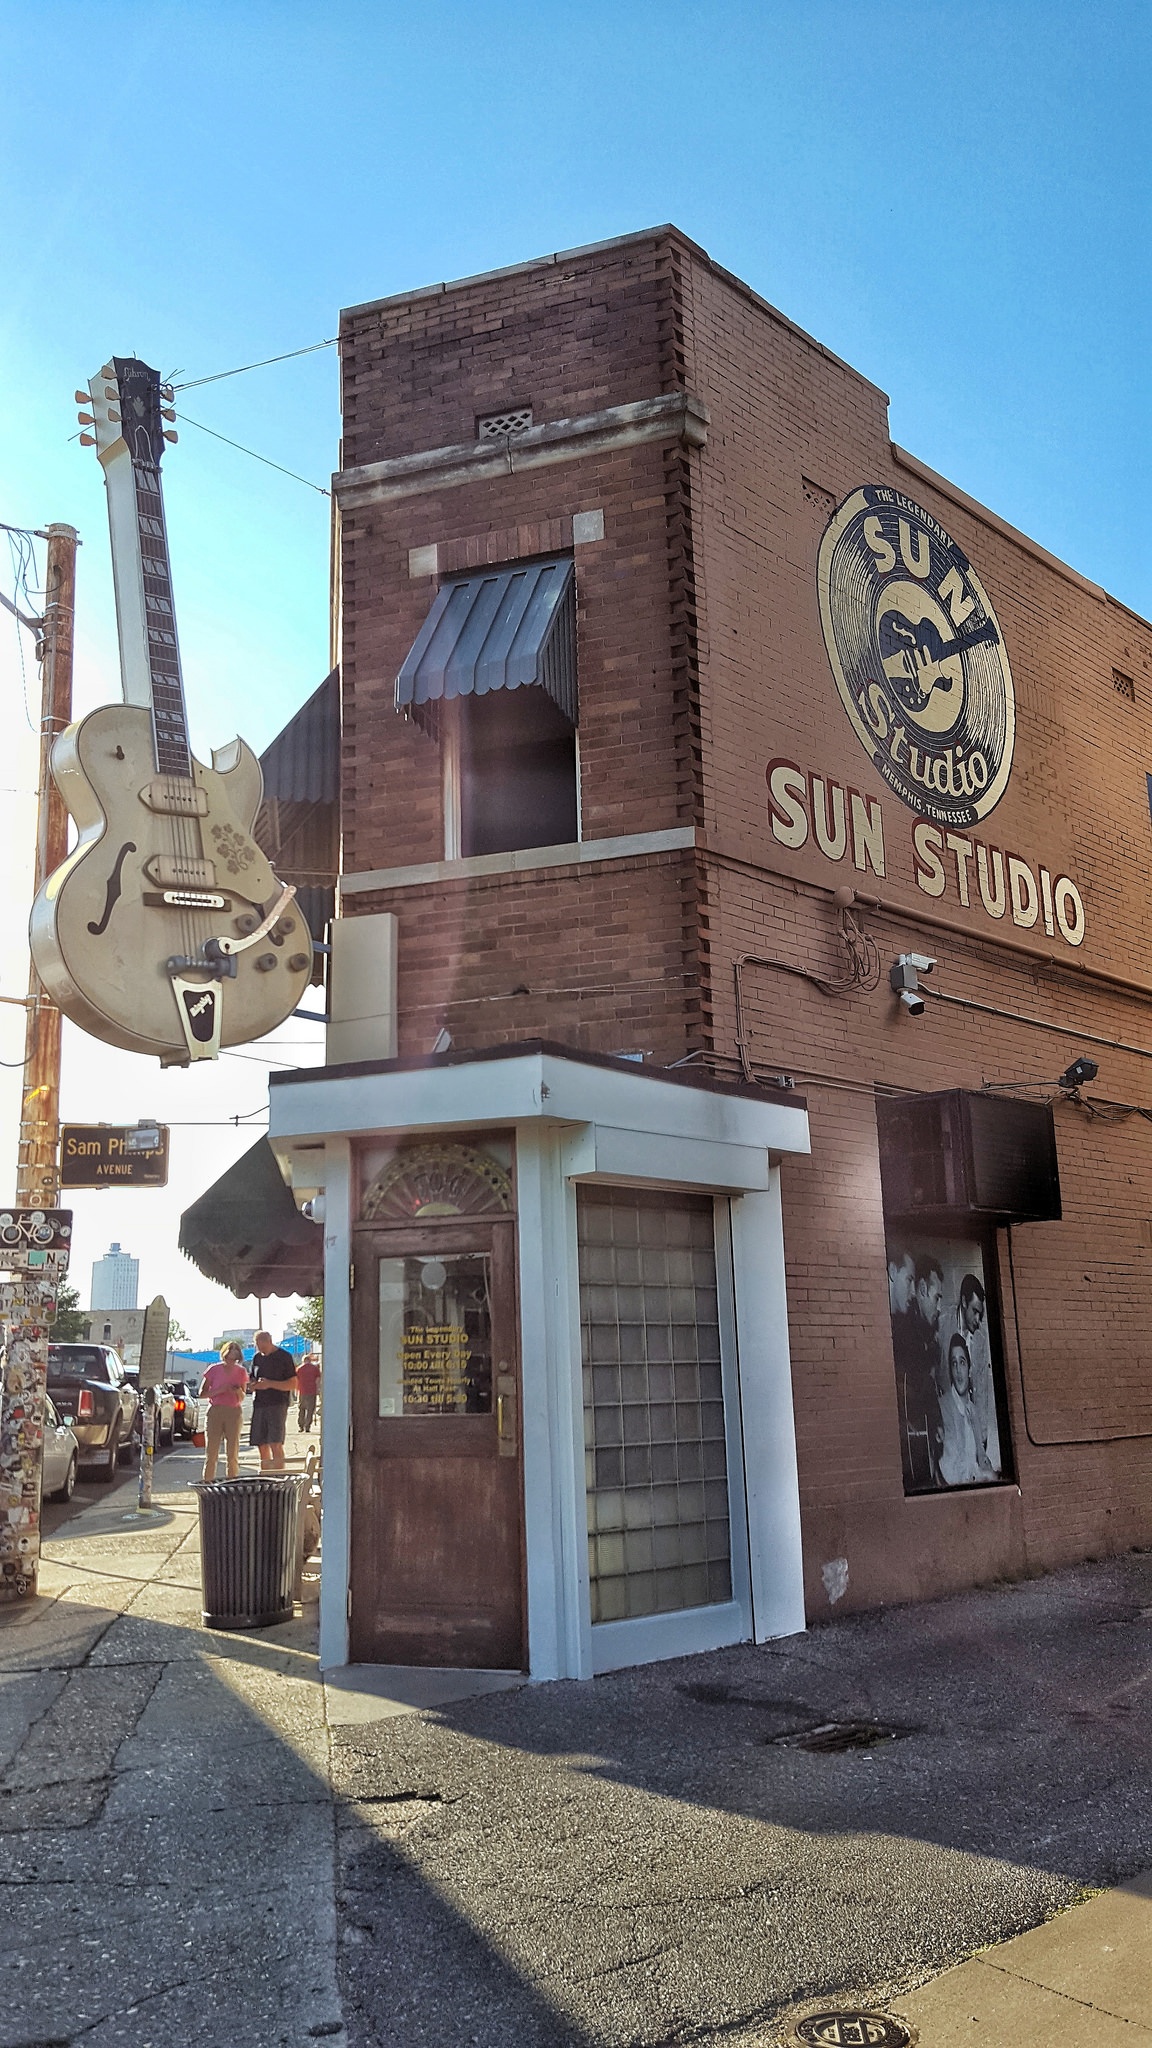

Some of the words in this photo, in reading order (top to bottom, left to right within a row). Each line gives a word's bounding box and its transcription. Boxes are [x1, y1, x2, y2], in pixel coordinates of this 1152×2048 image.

[875, 488, 894, 503] THE
[895, 492, 954, 549] LEGENDARY
[863, 516, 976, 628] SUN
[858, 683, 988, 797] Studio
[925, 804, 972, 824] TENNESSEE
[767, 759, 886, 878] SUN
[913, 817, 1085, 946] STUDIO
[67, 1138, 101, 1156] Sam
[108, 1138, 164, 1160] Phps
[96, 1164, 133, 1175] AVENUE
[401, 1334, 423, 1345] SUN
[426, 1333, 469, 1344] STUDIO
[397, 1351, 422, 1360] Open
[424, 1350, 451, 1360] Every
[453, 1350, 472, 1360] Day
[403, 1361, 428, 1370] 10:00
